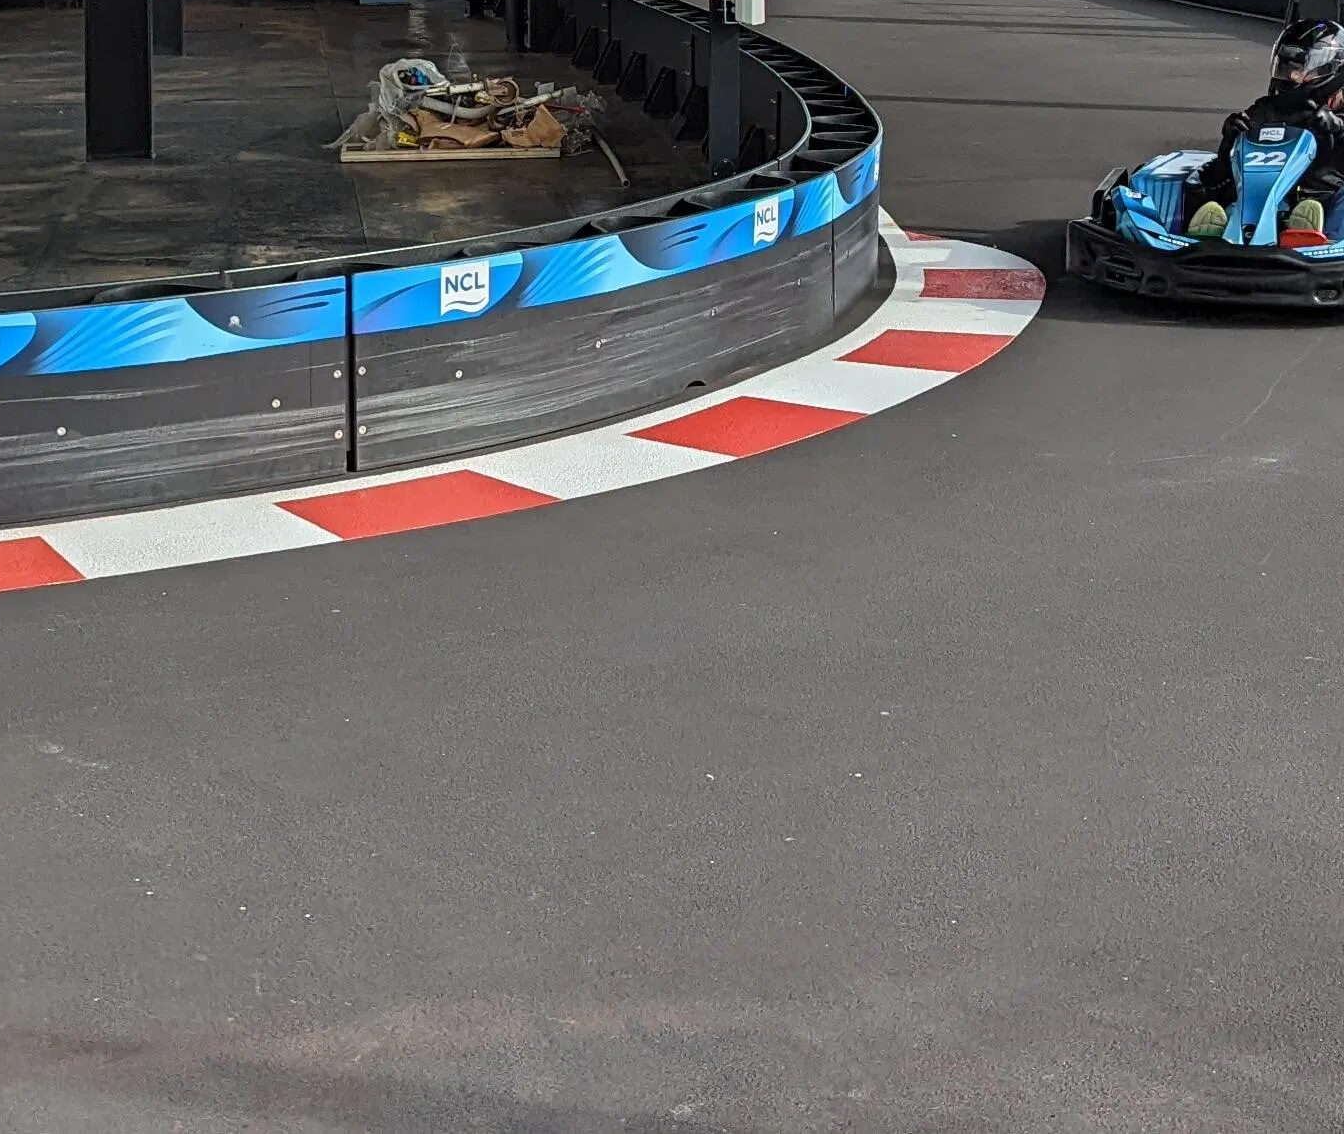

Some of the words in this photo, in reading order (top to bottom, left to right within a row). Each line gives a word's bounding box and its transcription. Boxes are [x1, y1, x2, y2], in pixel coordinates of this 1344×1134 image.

[1243, 150, 1287, 167] 22
[756, 206, 777, 227] NCL
[444, 271, 486, 295] NCL
